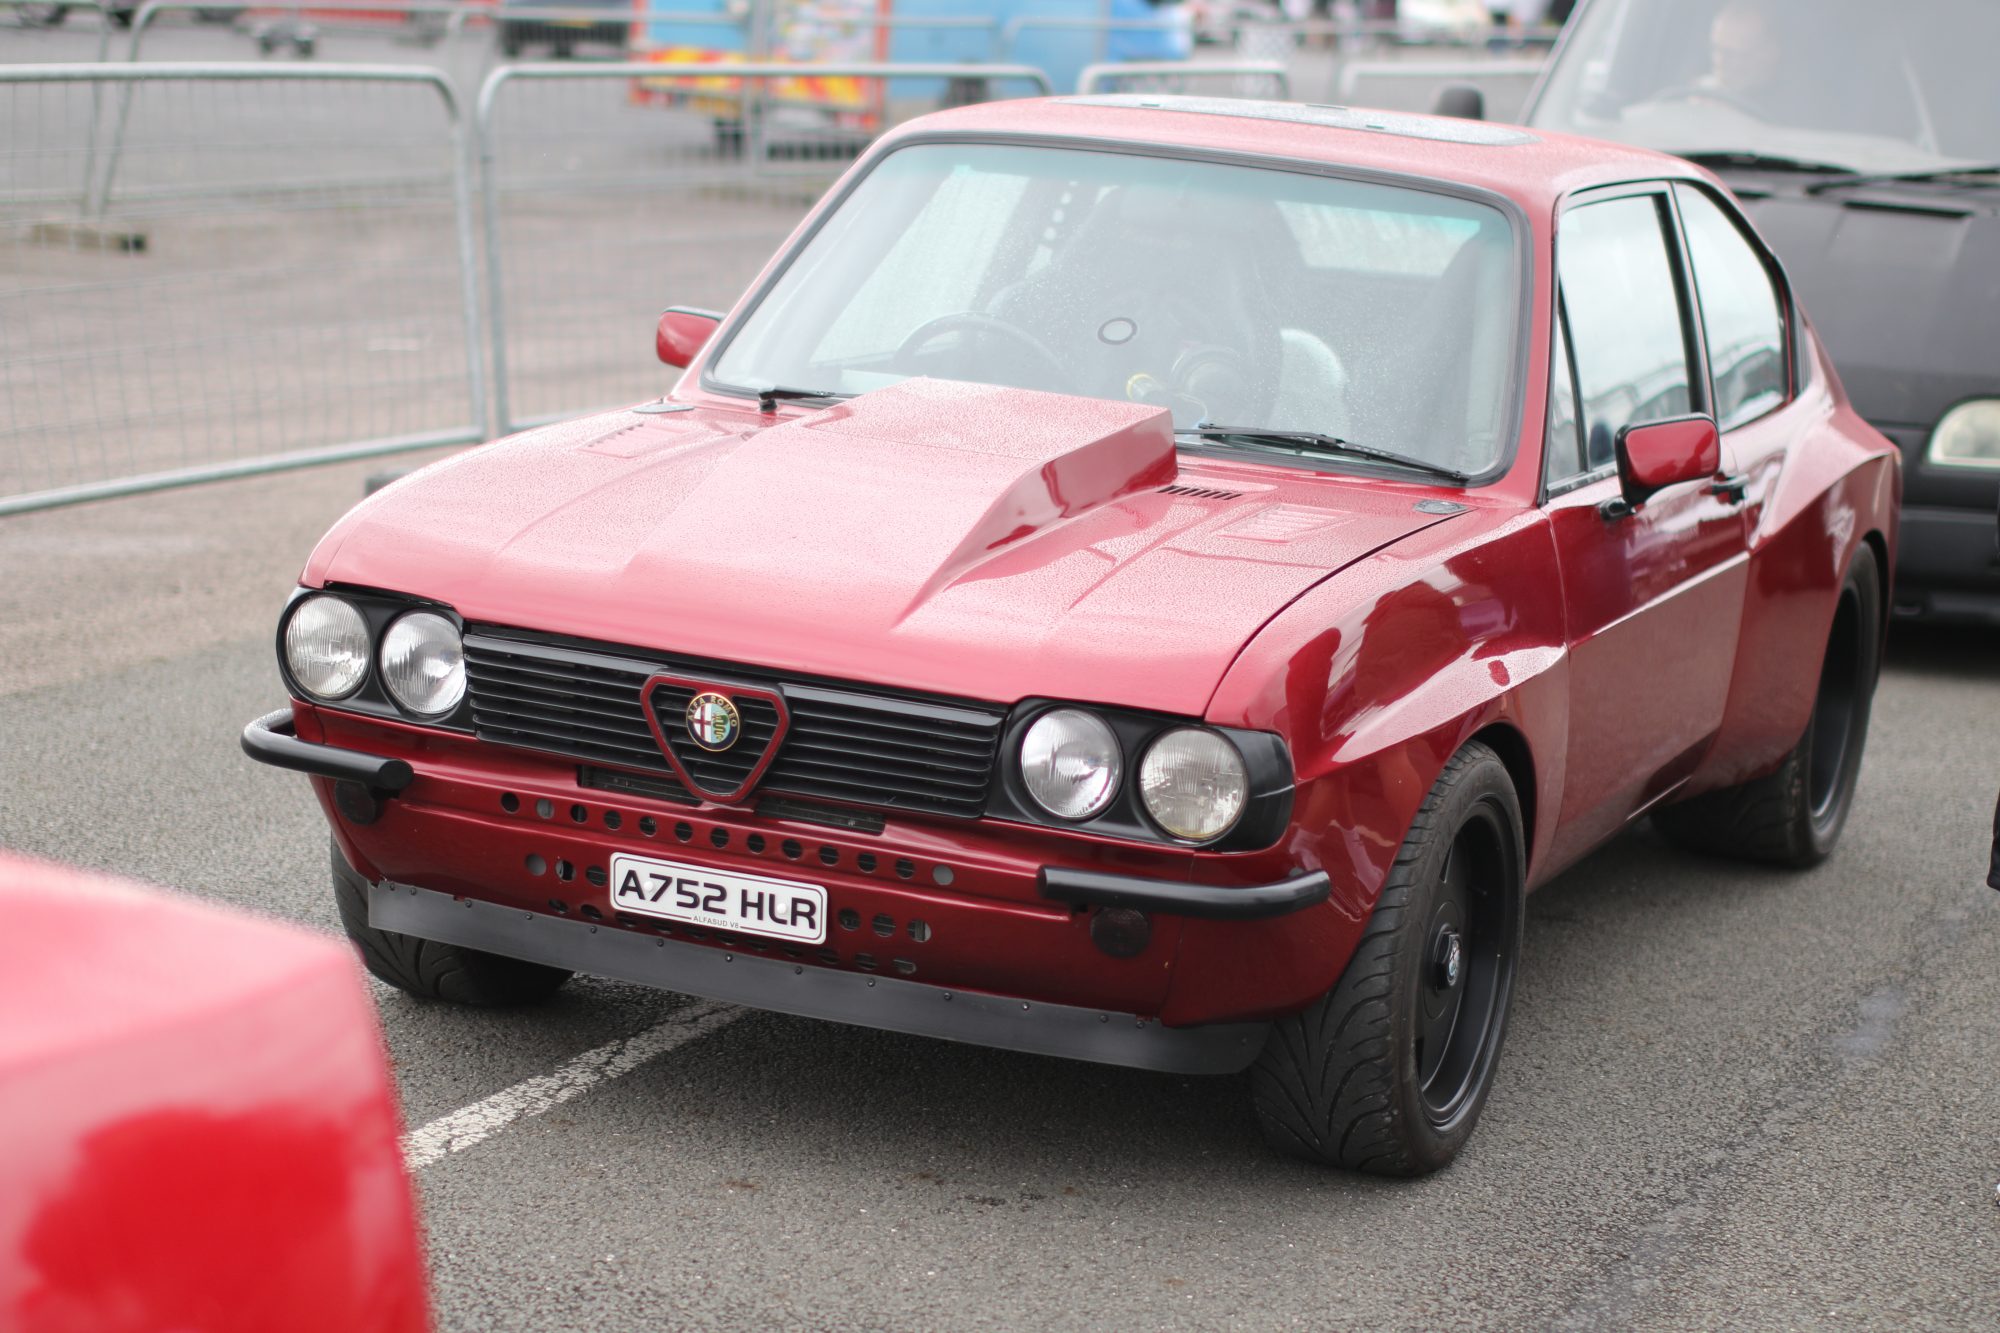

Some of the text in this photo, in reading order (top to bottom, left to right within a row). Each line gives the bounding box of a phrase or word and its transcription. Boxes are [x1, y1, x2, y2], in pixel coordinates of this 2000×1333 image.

[687, 695, 737, 727] ALFA ROMEO
[618, 869, 817, 930] A752 HLR
[693, 915, 728, 927] ALFASUD
